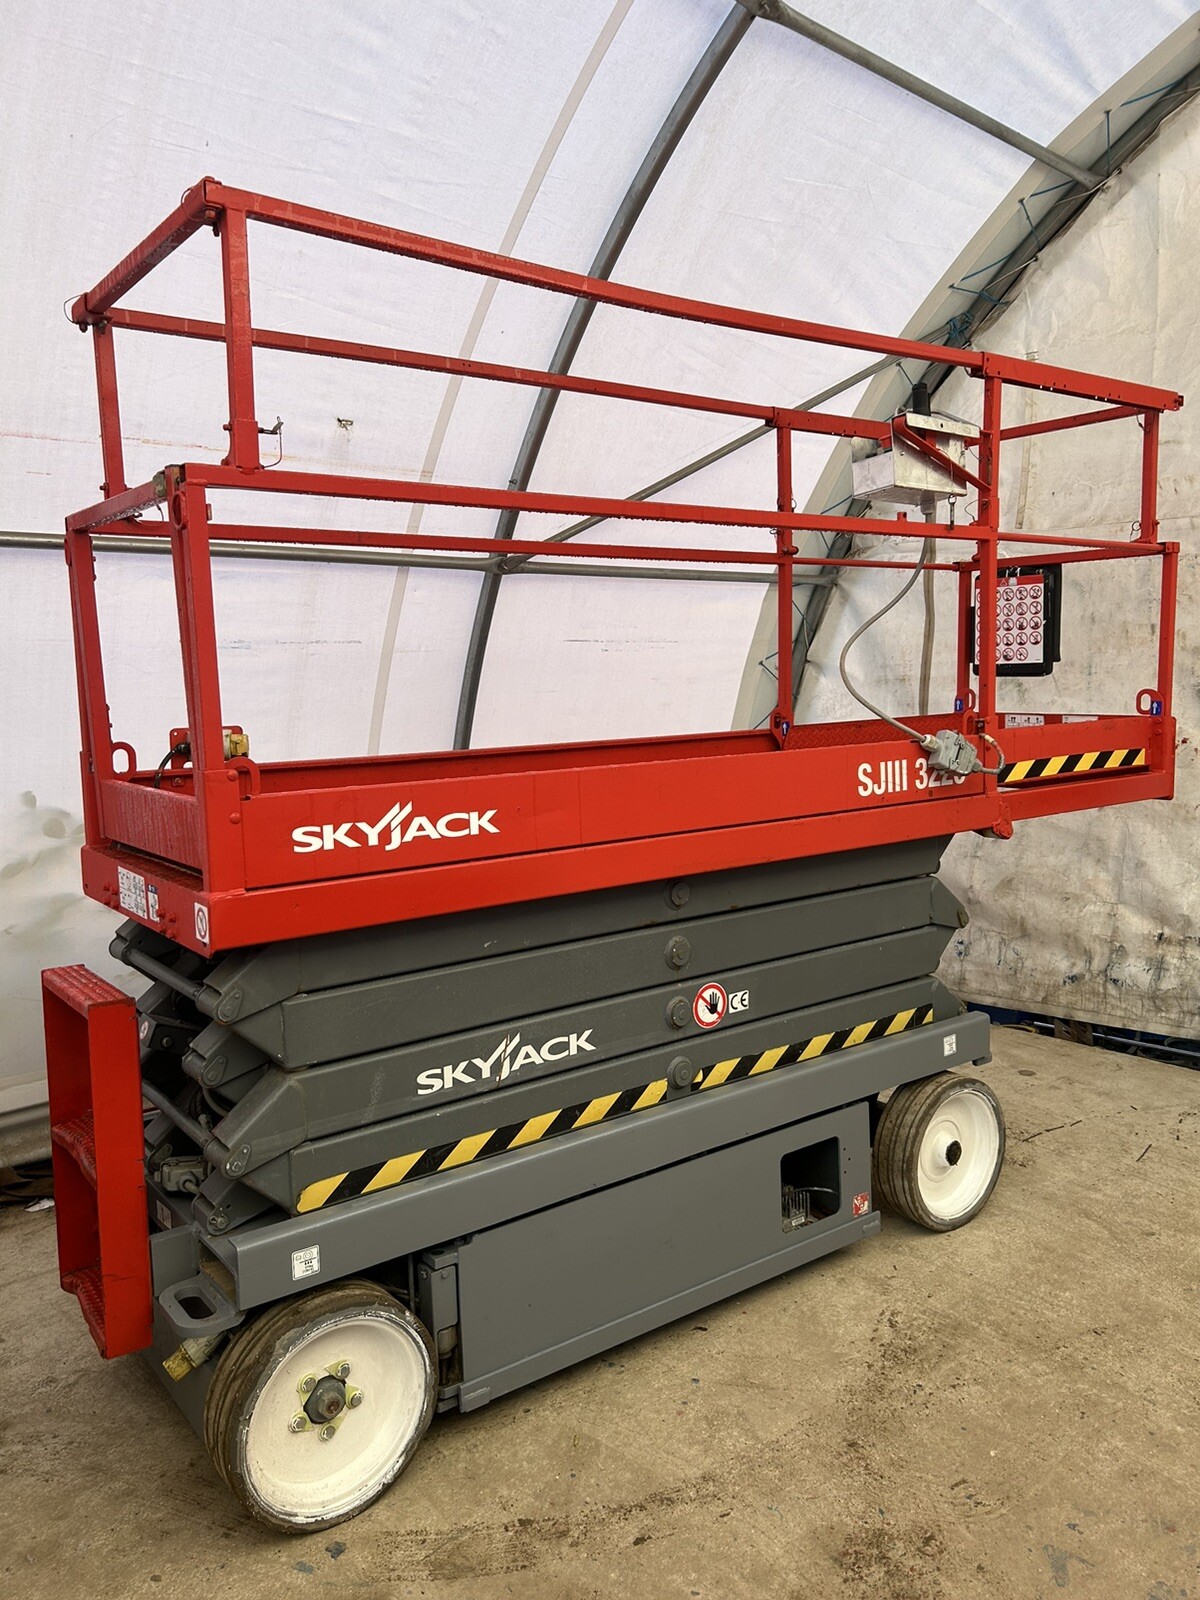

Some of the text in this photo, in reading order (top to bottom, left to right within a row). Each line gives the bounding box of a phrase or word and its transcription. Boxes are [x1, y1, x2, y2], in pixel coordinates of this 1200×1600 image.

[857, 759, 908, 797] SJIII
[291, 800, 501, 853] SKYJACK
[417, 1029, 597, 1095] SKYJACK
